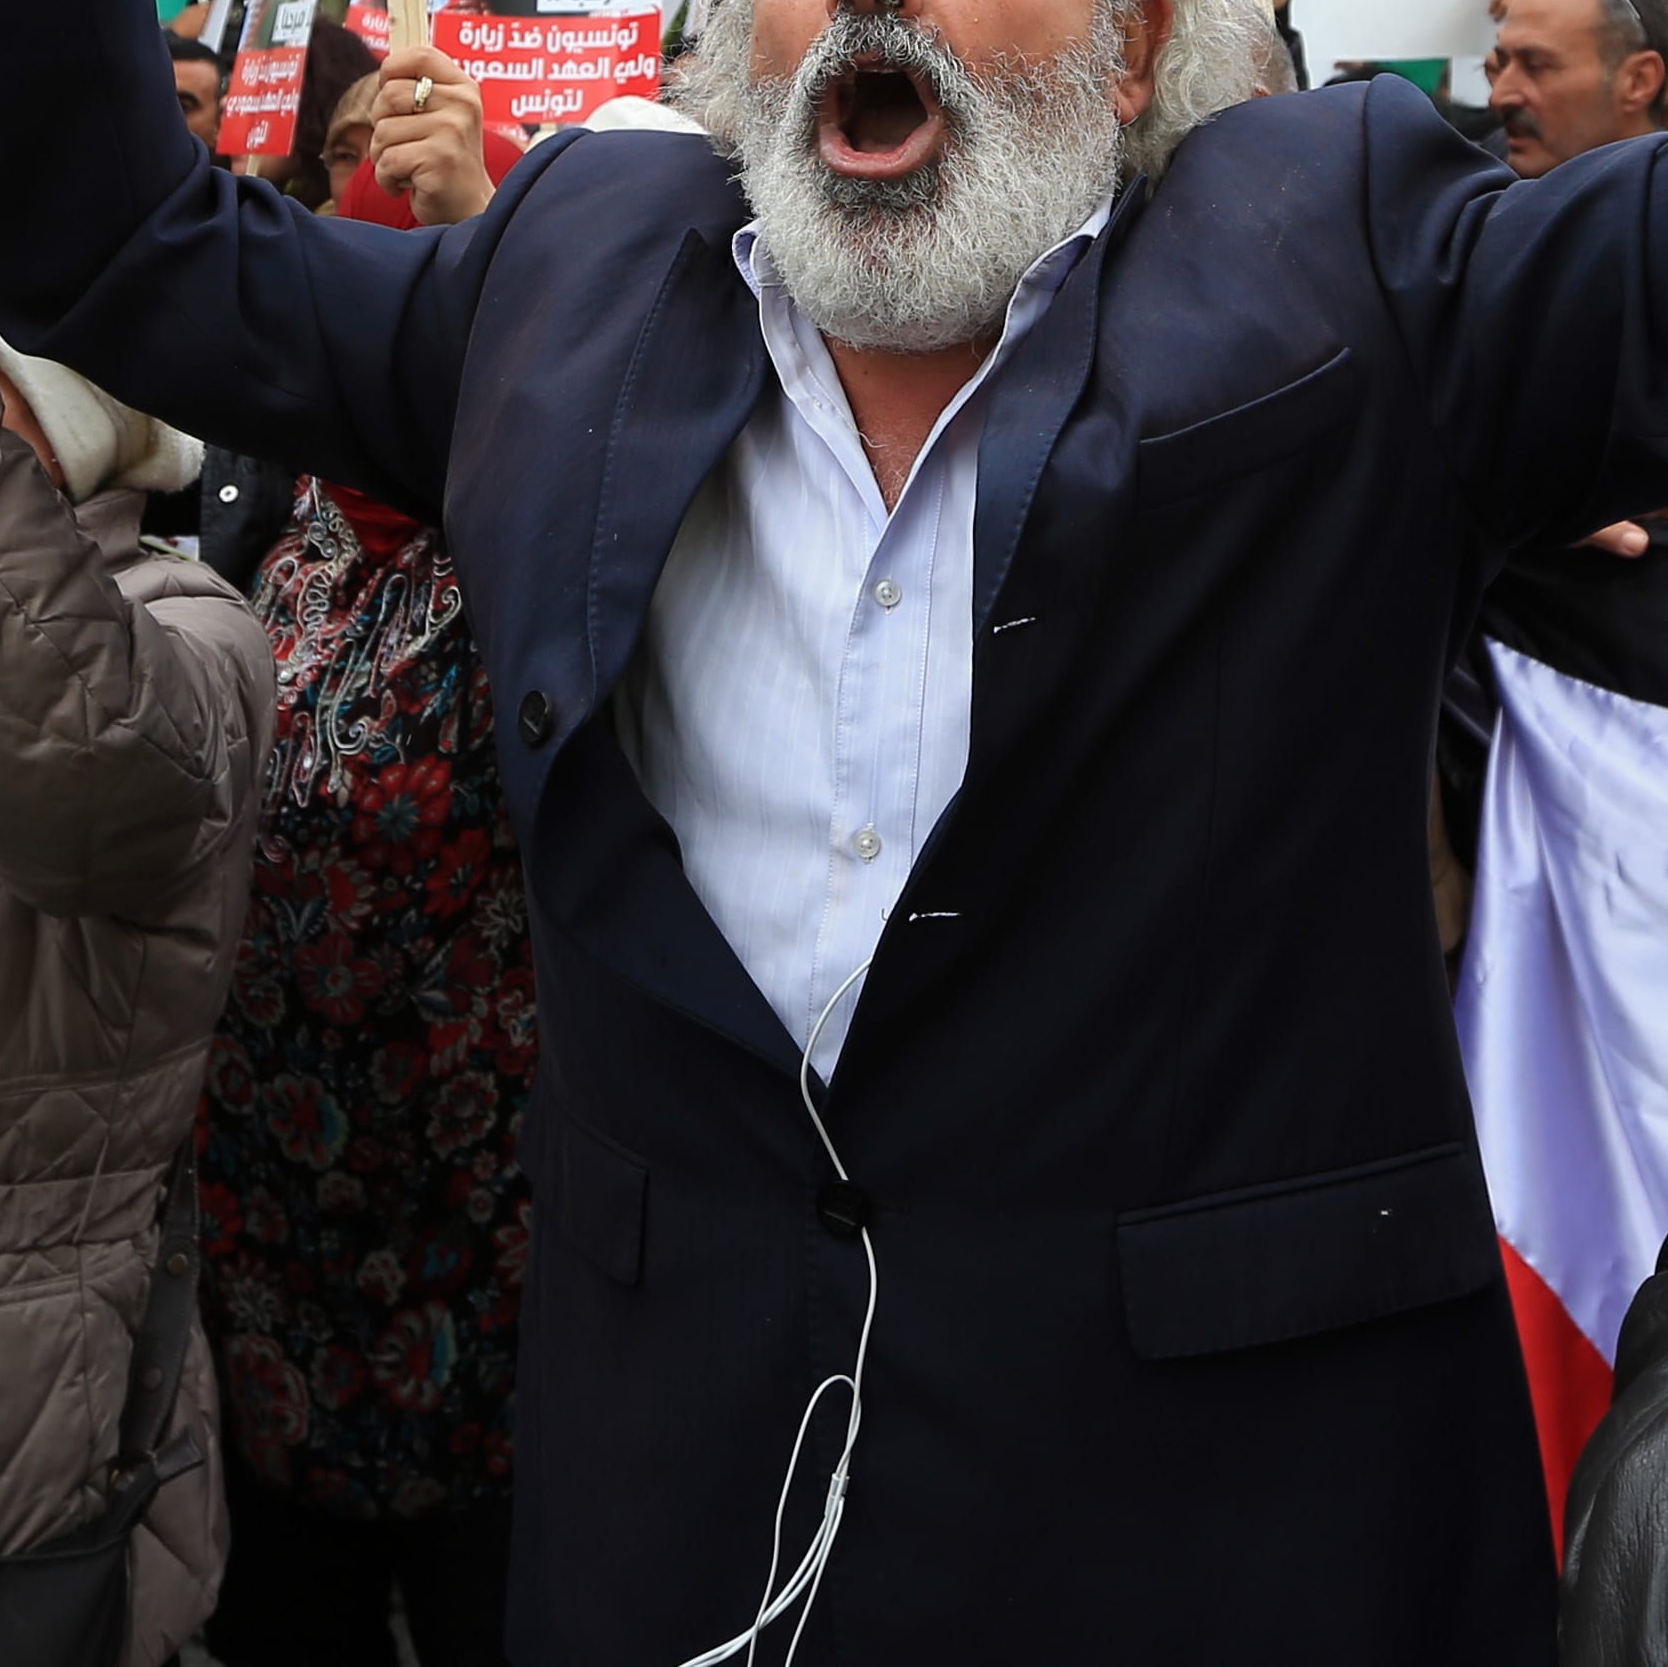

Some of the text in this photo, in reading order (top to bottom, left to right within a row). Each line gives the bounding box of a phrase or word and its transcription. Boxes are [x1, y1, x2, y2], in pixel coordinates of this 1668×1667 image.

[459, 20, 504, 52] زيارة
[546, 21, 639, 54] تونسيون
[454, 53, 657, 85] ولي العهد السعود
[510, 88, 584, 118] لتونس
